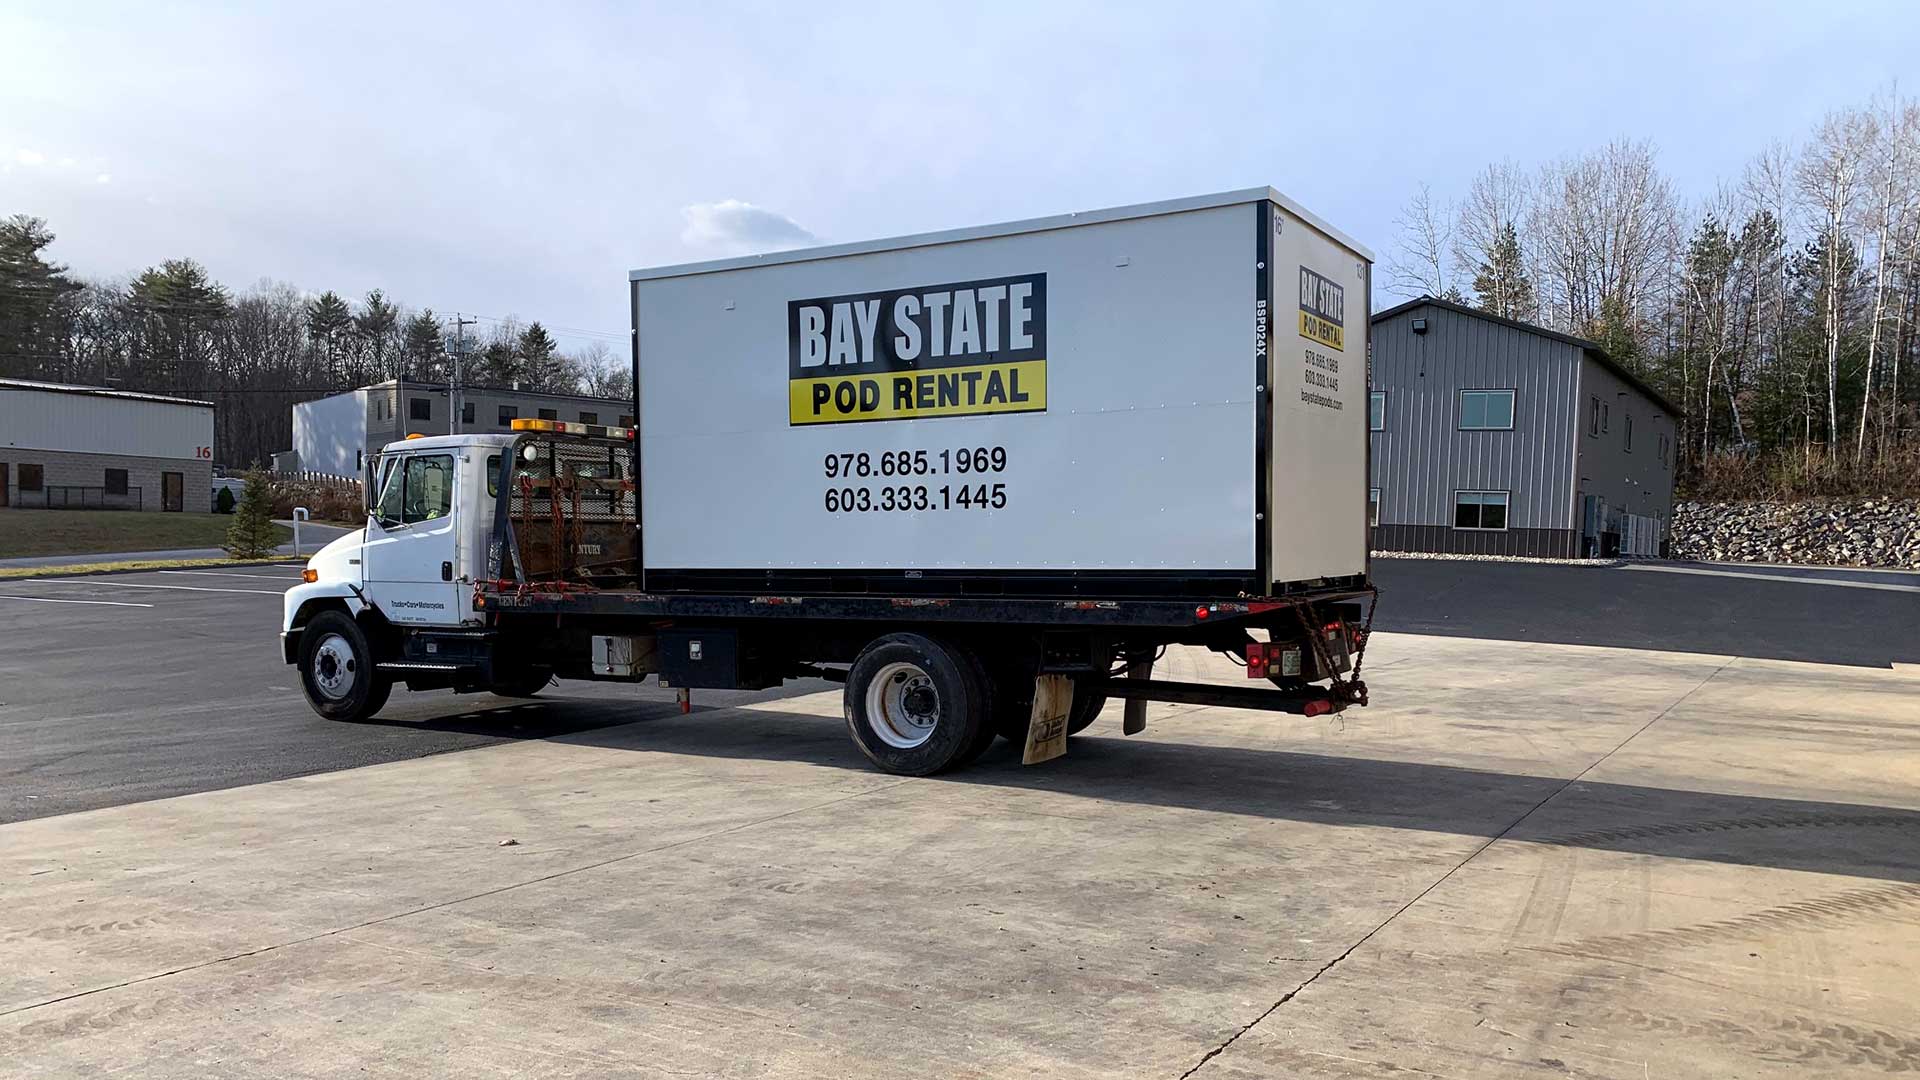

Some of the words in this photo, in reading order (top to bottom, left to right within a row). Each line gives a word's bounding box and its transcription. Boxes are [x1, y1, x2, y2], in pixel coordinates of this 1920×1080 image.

[1301, 270, 1318, 310] BAY
[1319, 279, 1342, 322] STATE
[800, 299, 881, 368] BAY
[894, 282, 1033, 361] STATE
[1256, 300, 1266, 356] BSP024X
[1303, 314, 1317, 336] POD
[1319, 320, 1341, 346] RENTAL
[1305, 349, 1338, 373] 978.685.1969
[812, 379, 880, 415] POD
[892, 368, 1029, 411] RENTAL
[1305, 369, 1338, 392] 603.333.1445
[195, 446, 211, 459] 16
[824, 446, 1007, 478] 978.685.1969
[824, 483, 1007, 513] 603.333.1445
[570, 543, 601, 555] CNTURY
